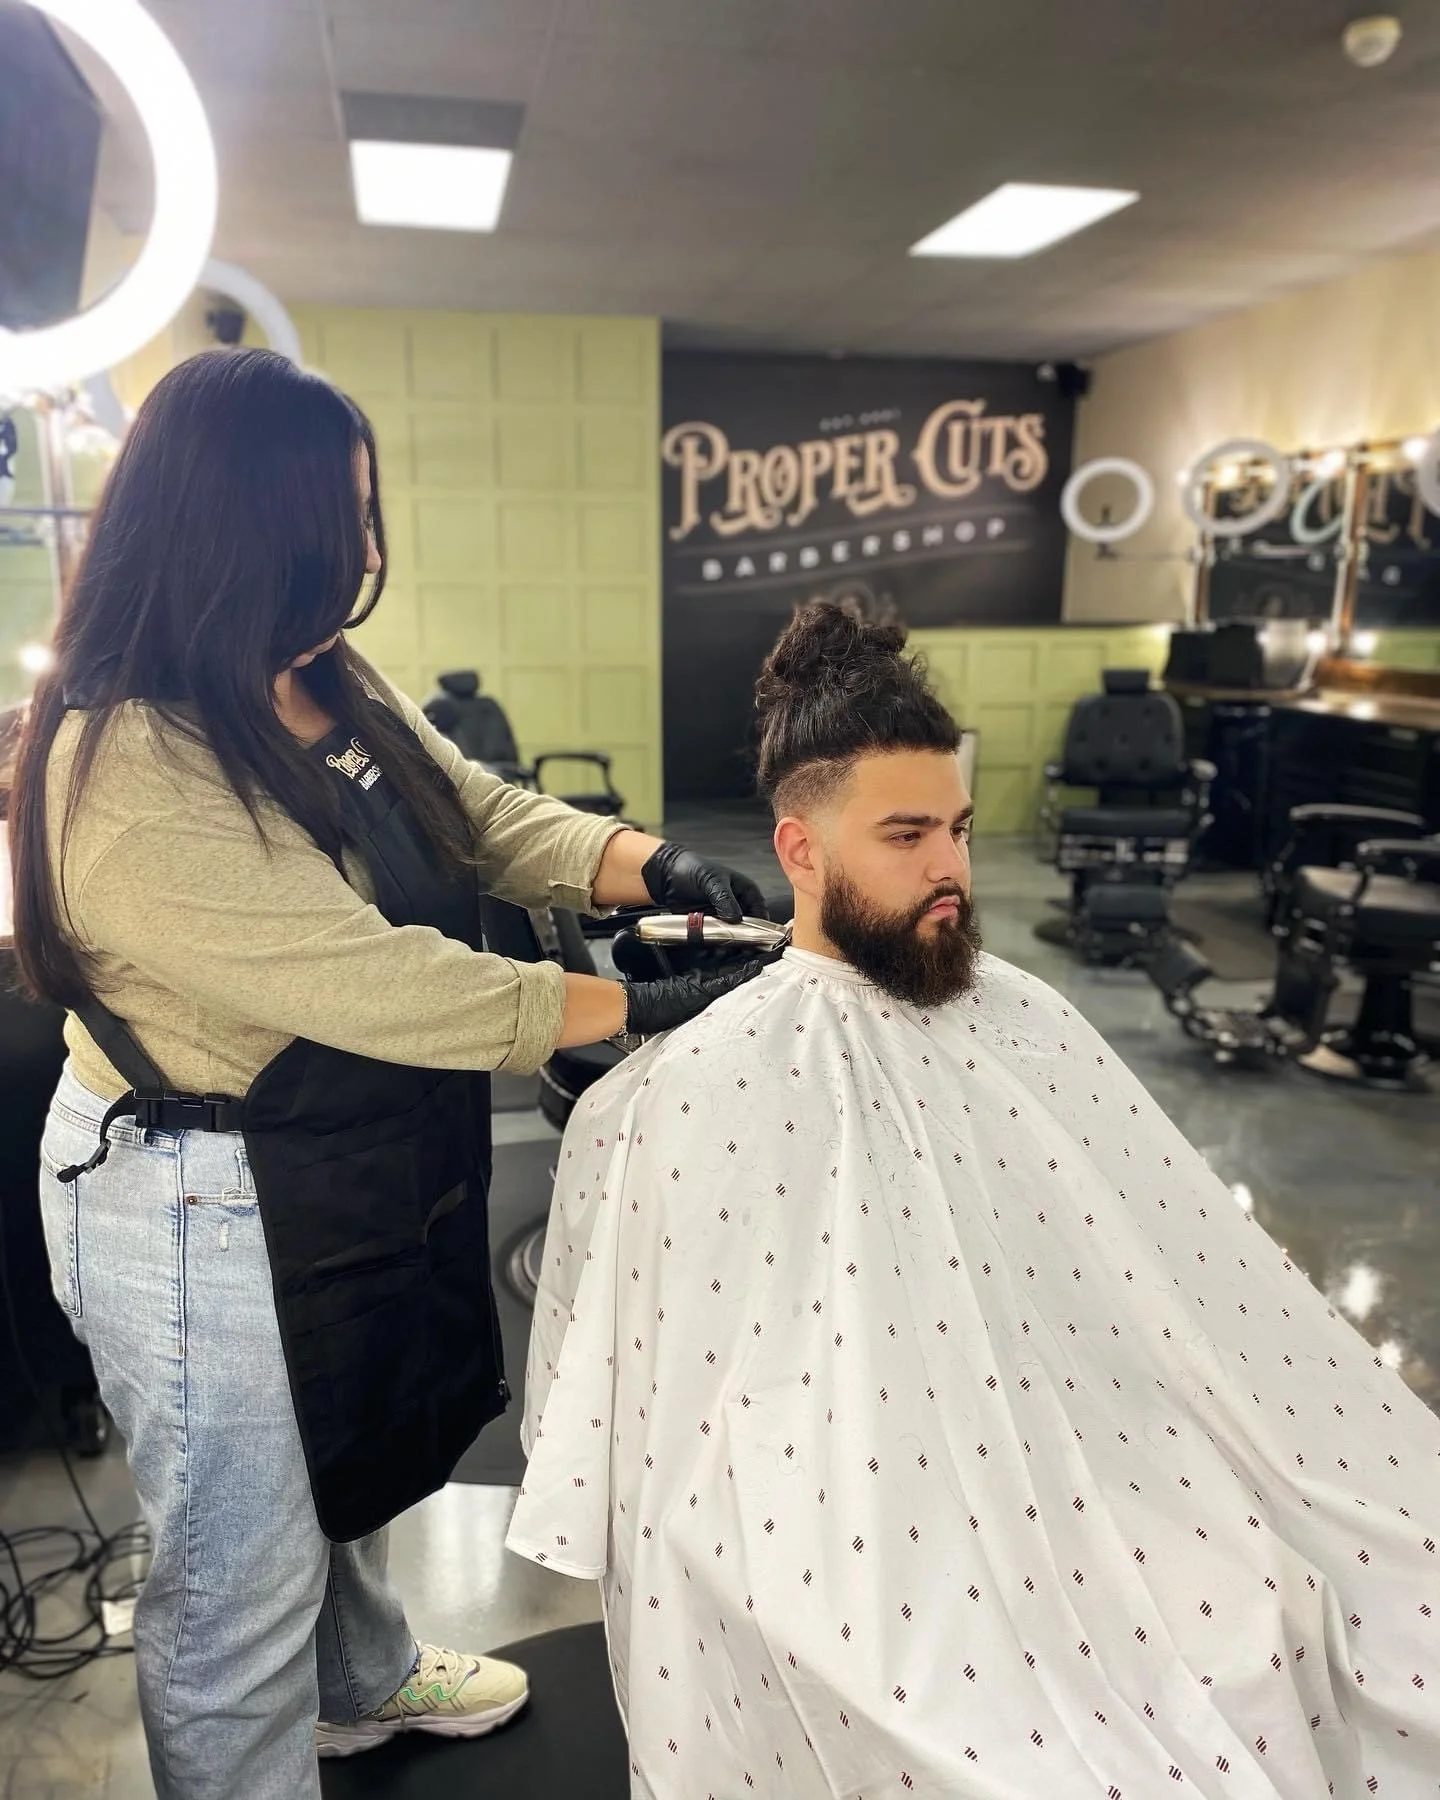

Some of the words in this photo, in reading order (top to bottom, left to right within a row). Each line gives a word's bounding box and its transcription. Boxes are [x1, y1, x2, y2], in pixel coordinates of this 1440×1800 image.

[662, 421, 917, 541] PROPER
[911, 399, 1049, 497] CUTS
[702, 518, 1006, 582] BARBERSHOP
